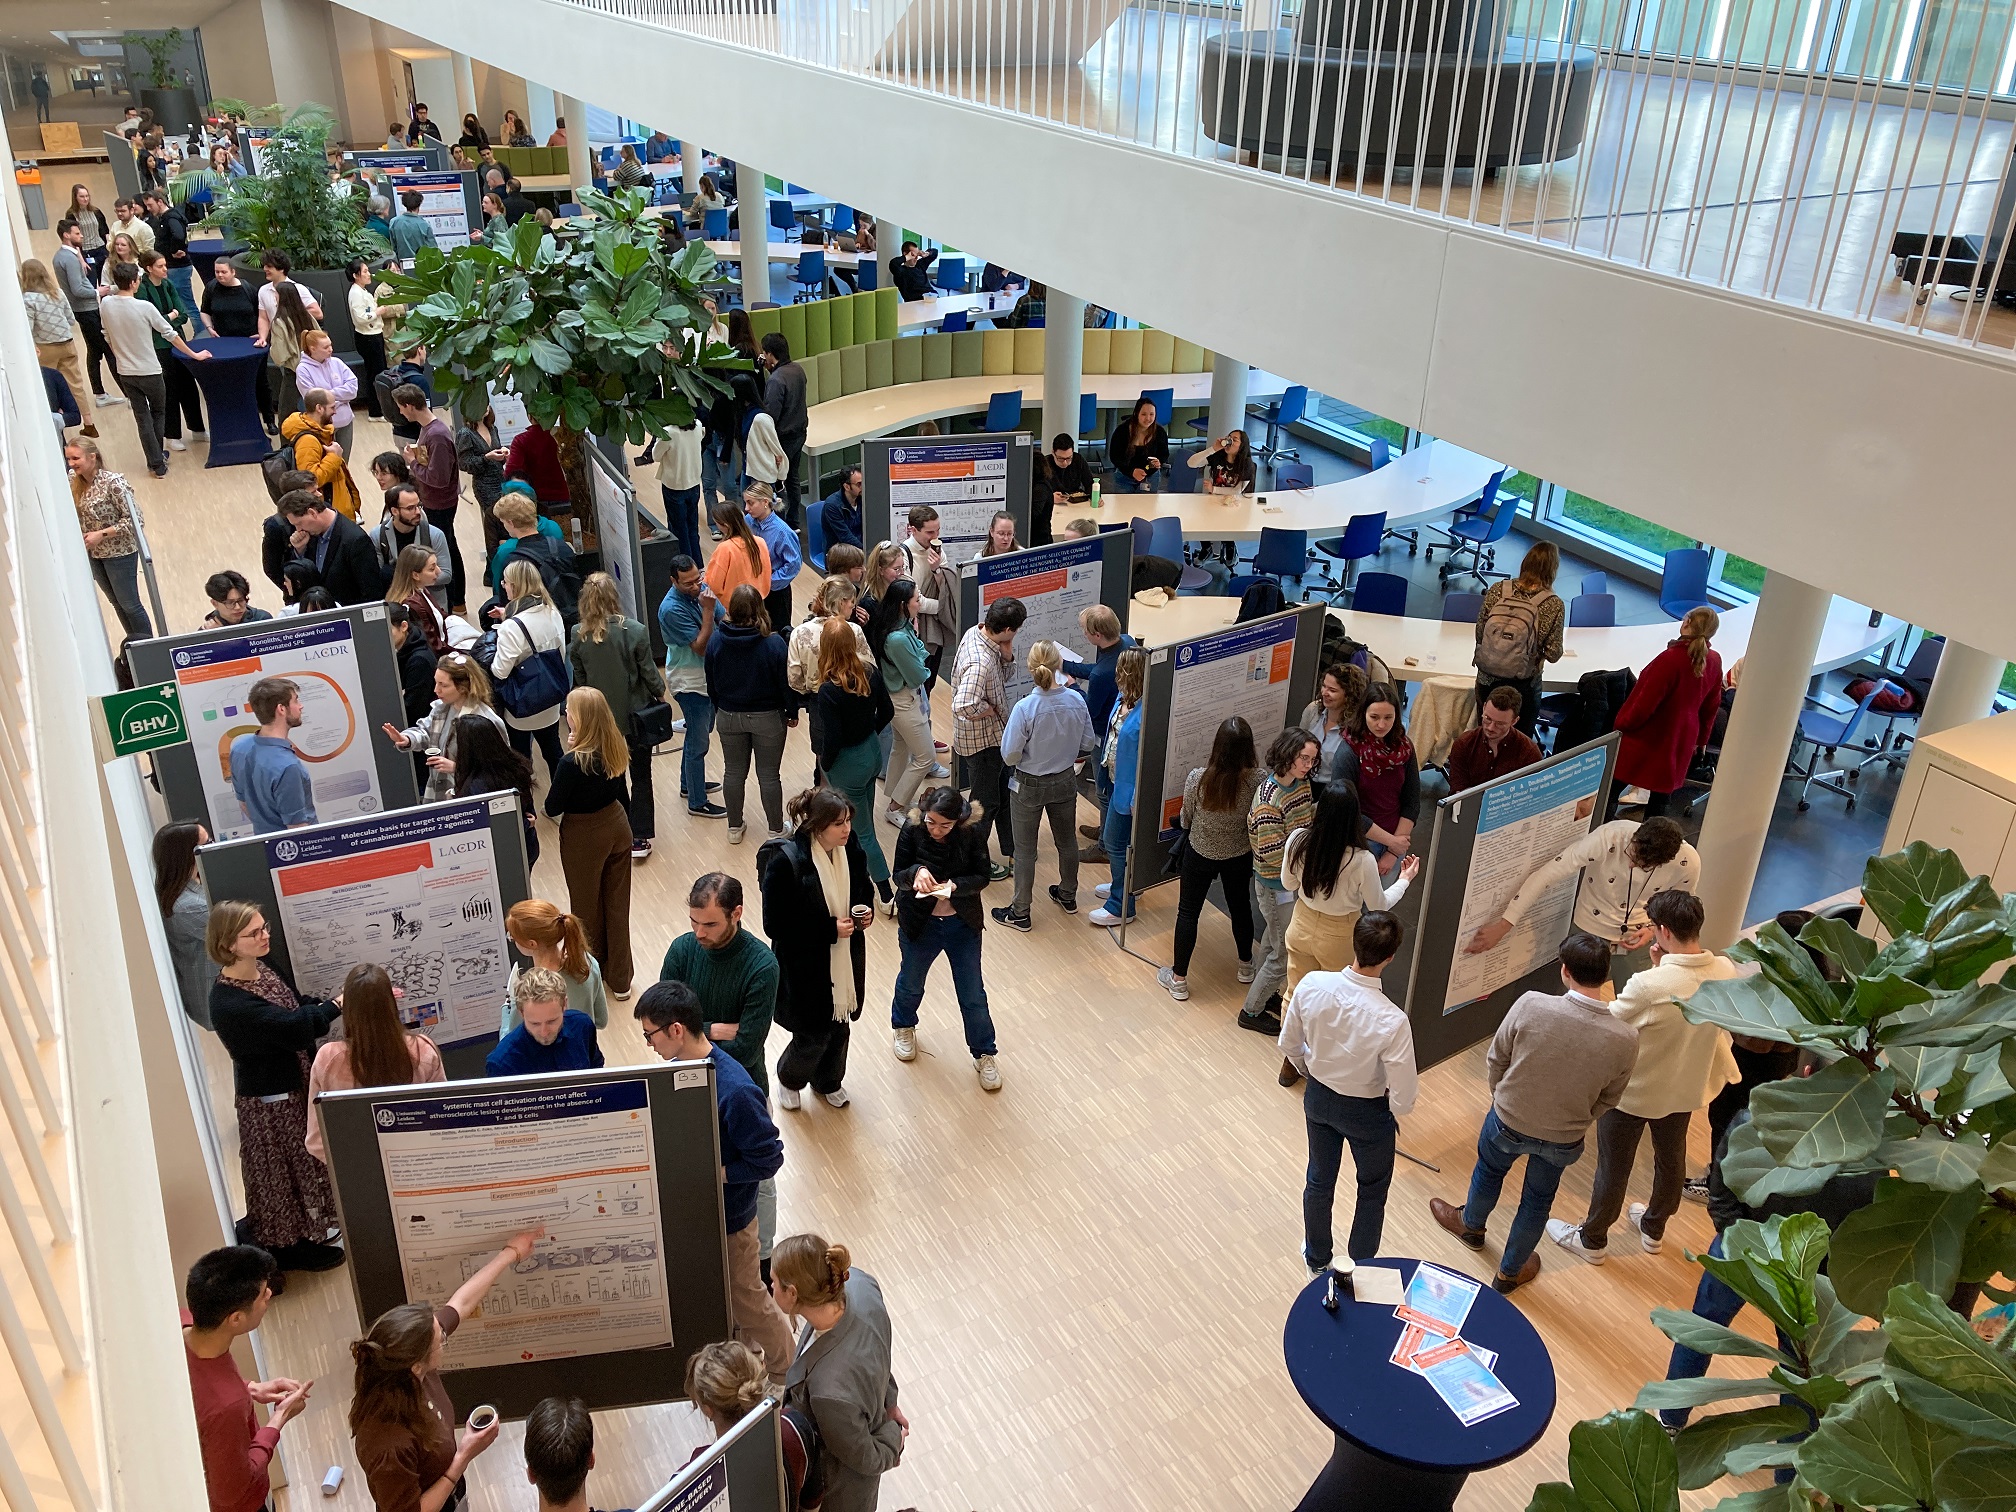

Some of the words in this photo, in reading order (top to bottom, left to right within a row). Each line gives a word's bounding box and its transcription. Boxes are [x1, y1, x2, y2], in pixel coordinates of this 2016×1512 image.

[977, 463, 1005, 471] LACDR
[989, 560, 1021, 571] DEVELOPMENT
[249, 635, 283, 647] Monoliths,
[294, 630, 315, 639] distant
[316, 626, 335, 635] future
[259, 642, 291, 653] automated
[292, 639, 305, 647] SPE
[304, 645, 348, 661] LACDR
[130, 714, 168, 735] BHV
[341, 828, 377, 841] Molecular
[380, 824, 398, 833] basis
[413, 818, 435, 828] target
[437, 809, 481, 823] engagement
[360, 832, 404, 845] cannabinoid
[406, 826, 436, 838] receptor
[444, 818, 474, 831] agonists
[299, 835, 336, 847] Universiteit
[301, 844, 322, 853] Leiden
[439, 839, 486, 858] LACDR
[332, 883, 371, 895] INTRODUCTION
[365, 905, 404, 917] EXPERIMENTAL
[391, 945, 411, 953] RESULTS
[678, 1072, 699, 1083] B3
[443, 1102, 472, 1111] Systemic
[491, 1098, 503, 1107] cell
[504, 1095, 536, 1105] activation
[538, 1094, 554, 1102] does
[568, 1091, 587, 1099] affect
[429, 1109, 479, 1121] atherosclerotic
[480, 1107, 500, 1116] lesion
[501, 1103, 545, 1115] development
[567, 1098, 593, 1107] absence
[496, 1136, 537, 1145] Introduction
[492, 1189, 535, 1200] Experimental
[537, 1187, 556, 1197] setup
[486, 1319, 524, 1329] Conclusions
[526, 1317, 536, 1325] and
[538, 1315, 558, 1323] future
[559, 1311, 599, 1321] perspectives
[1419, 1352, 1436, 1361] SPRING
[1434, 1343, 1460, 1355] SYMPOSIUM
[669, 1475, 712, 1512] INE-BASED
[681, 1481, 713, 1512] ELIVERY
